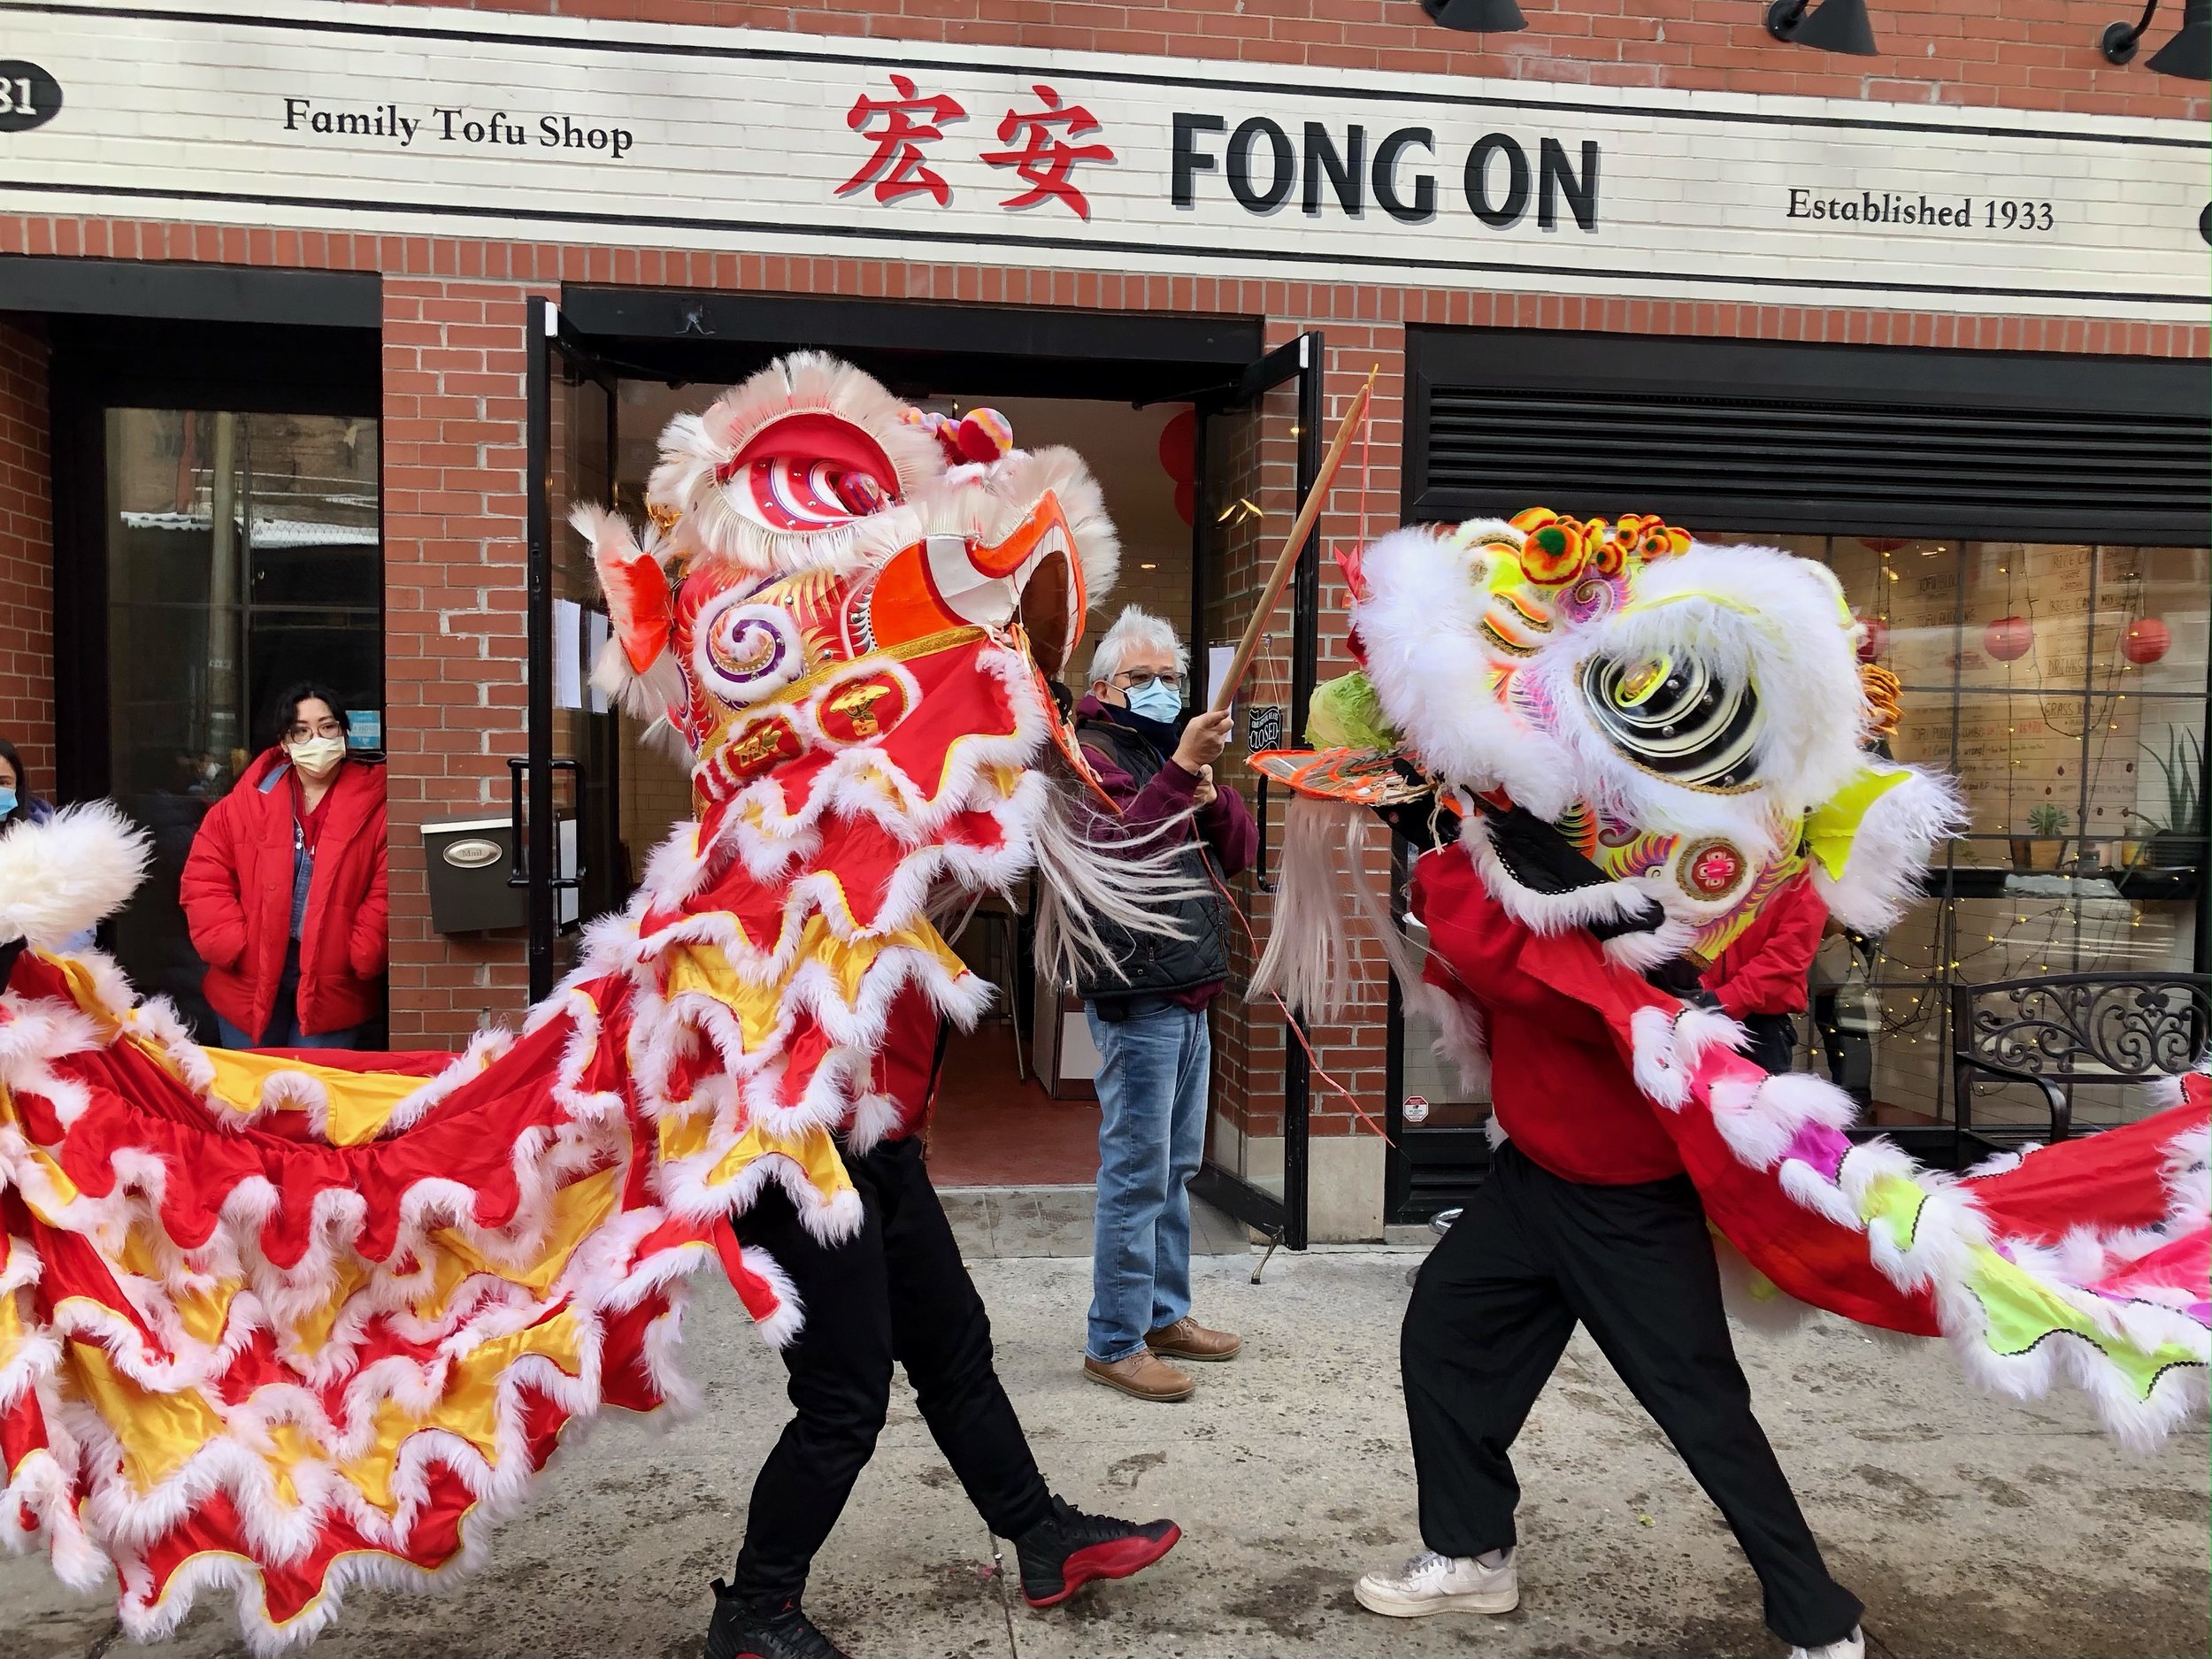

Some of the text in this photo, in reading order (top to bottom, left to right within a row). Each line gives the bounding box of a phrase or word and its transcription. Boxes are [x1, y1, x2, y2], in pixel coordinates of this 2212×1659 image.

[283, 97, 634, 159] Family Tofu Shop
[833, 73, 1116, 221] 宏安
[1171, 111, 1600, 231] FONG ON
[1786, 188, 2055, 231] Established 1933
[1248, 722, 1279, 749] CLOSED
